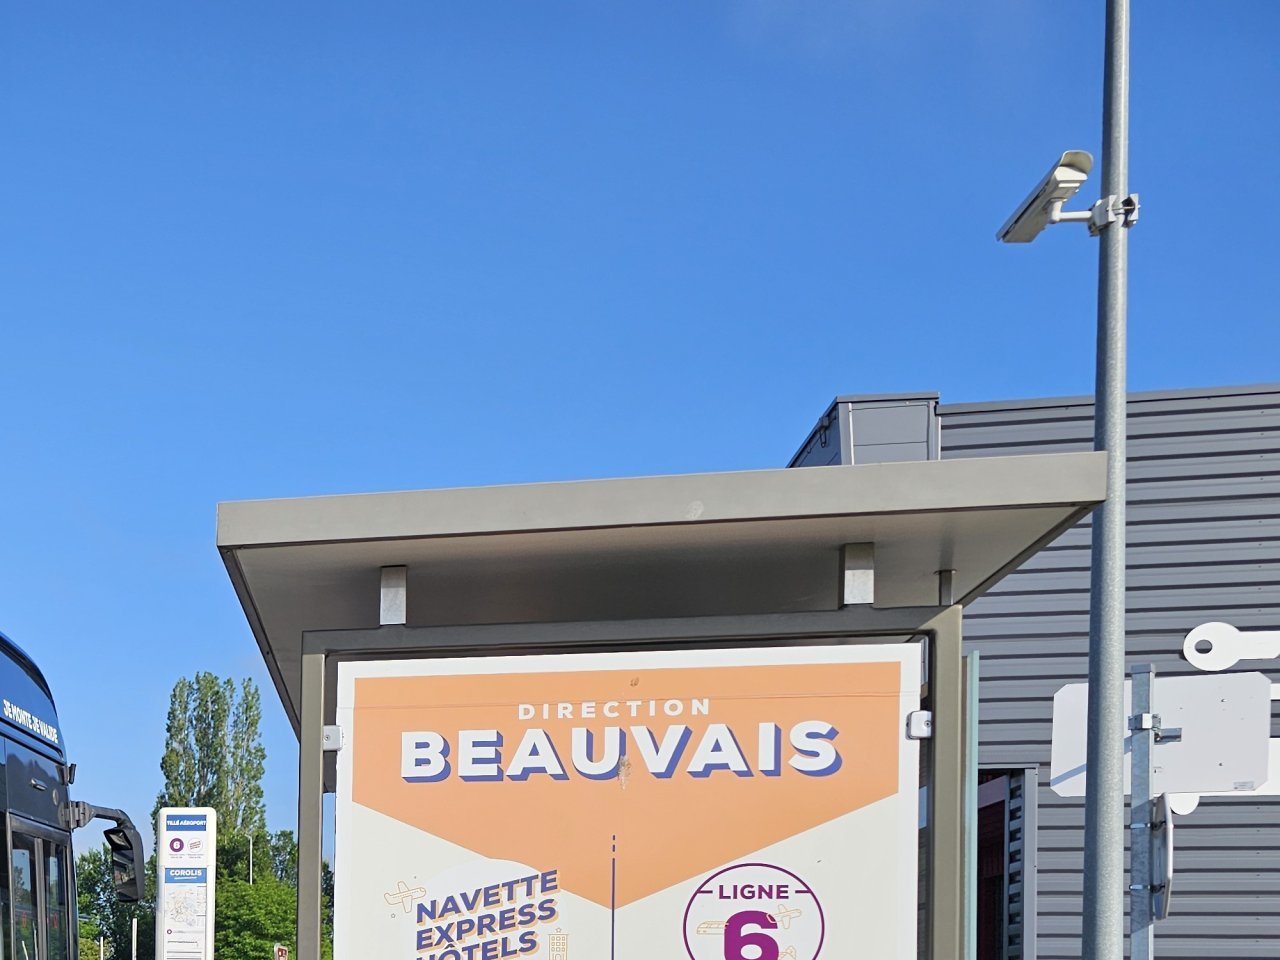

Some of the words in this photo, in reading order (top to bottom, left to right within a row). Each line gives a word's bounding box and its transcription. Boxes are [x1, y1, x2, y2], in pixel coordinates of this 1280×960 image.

[519, 699, 710, 721] DIRECTION
[401, 720, 842, 784] BEAUVAIS
[416, 869, 560, 926] NAVETTE
[718, 883, 790, 901] LIGNE
[416, 898, 558, 953] EXPRESS
